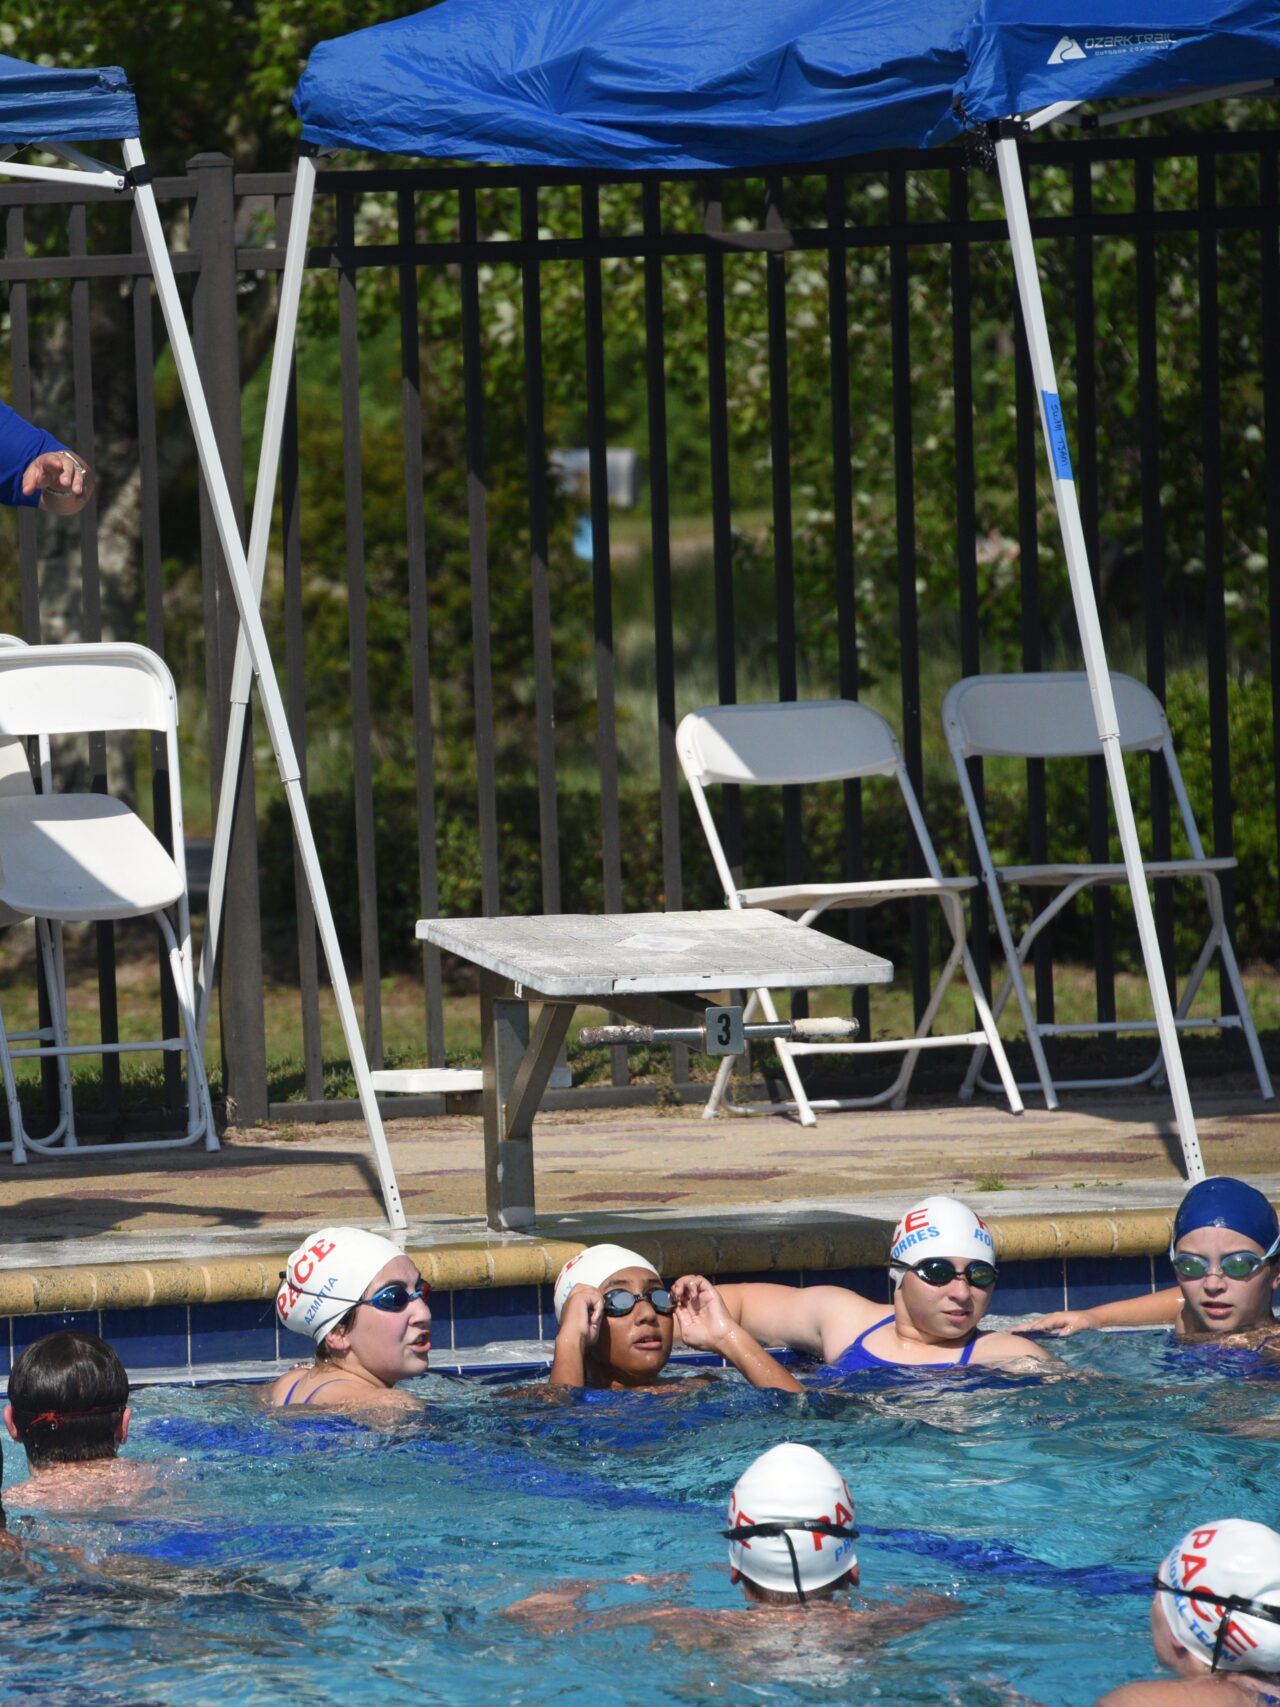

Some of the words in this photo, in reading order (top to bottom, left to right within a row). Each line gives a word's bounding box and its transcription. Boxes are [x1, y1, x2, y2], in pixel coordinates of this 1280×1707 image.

[717, 1013, 731, 1046] 3
[892, 1226, 940, 1259] ORRES
[276, 1238, 337, 1322] PACE
[1182, 1529, 1259, 1657] PACE
